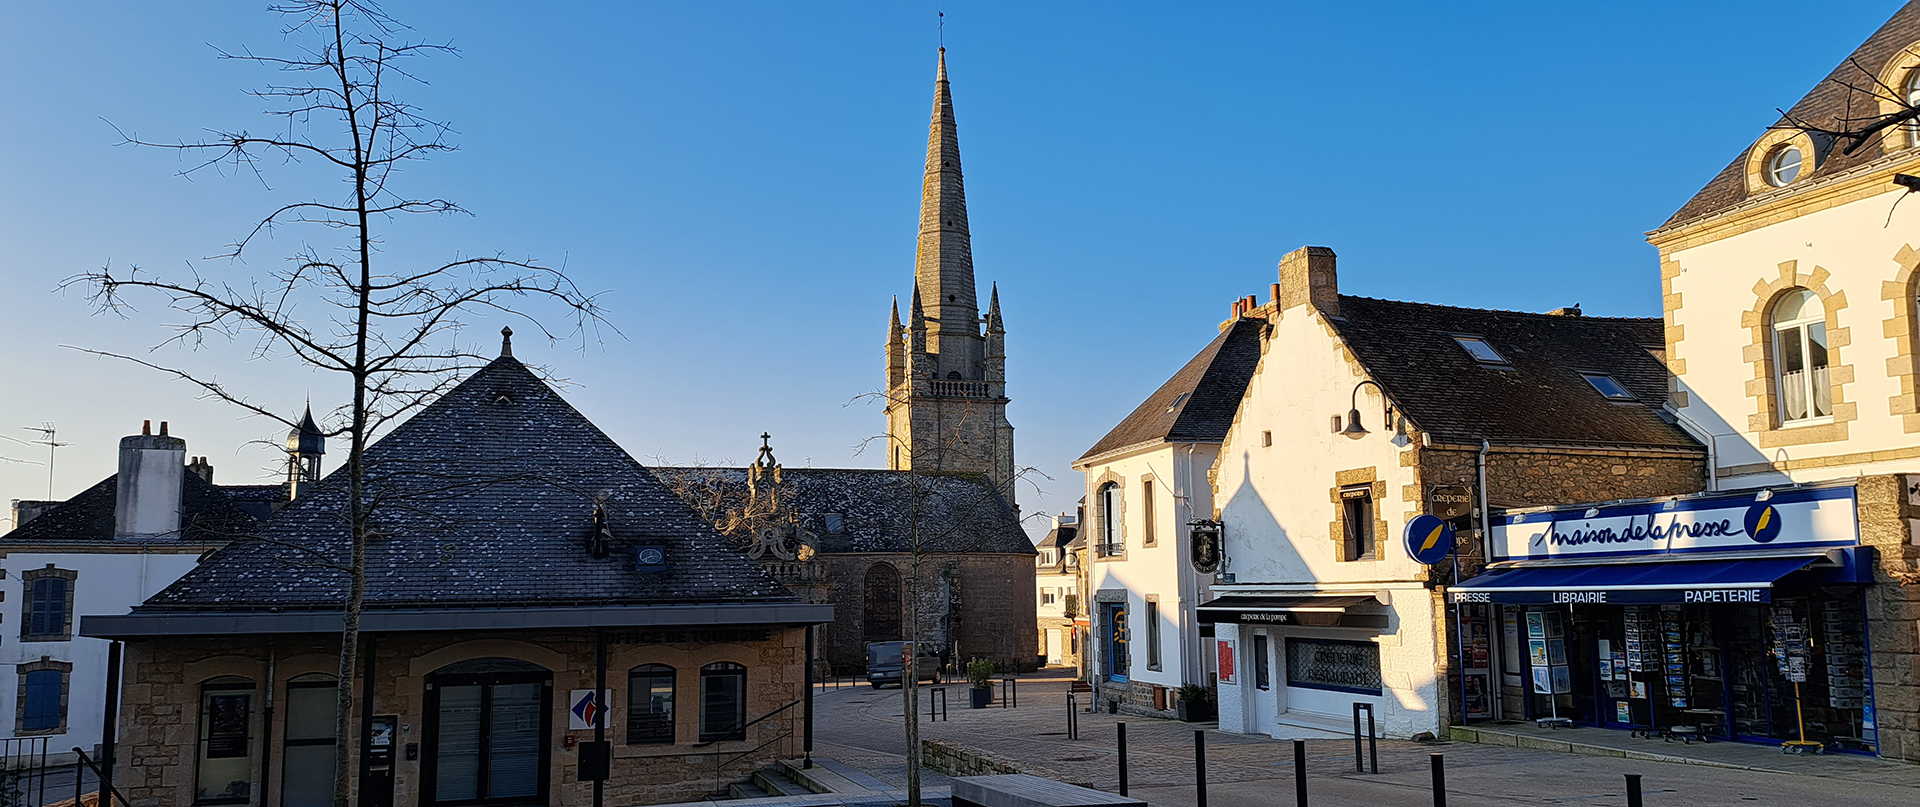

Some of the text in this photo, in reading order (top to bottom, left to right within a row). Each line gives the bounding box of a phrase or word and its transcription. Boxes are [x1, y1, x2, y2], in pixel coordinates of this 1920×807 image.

[1454, 589, 1761, 604] PRESSE LIBRAIRIE PAPETERIE
